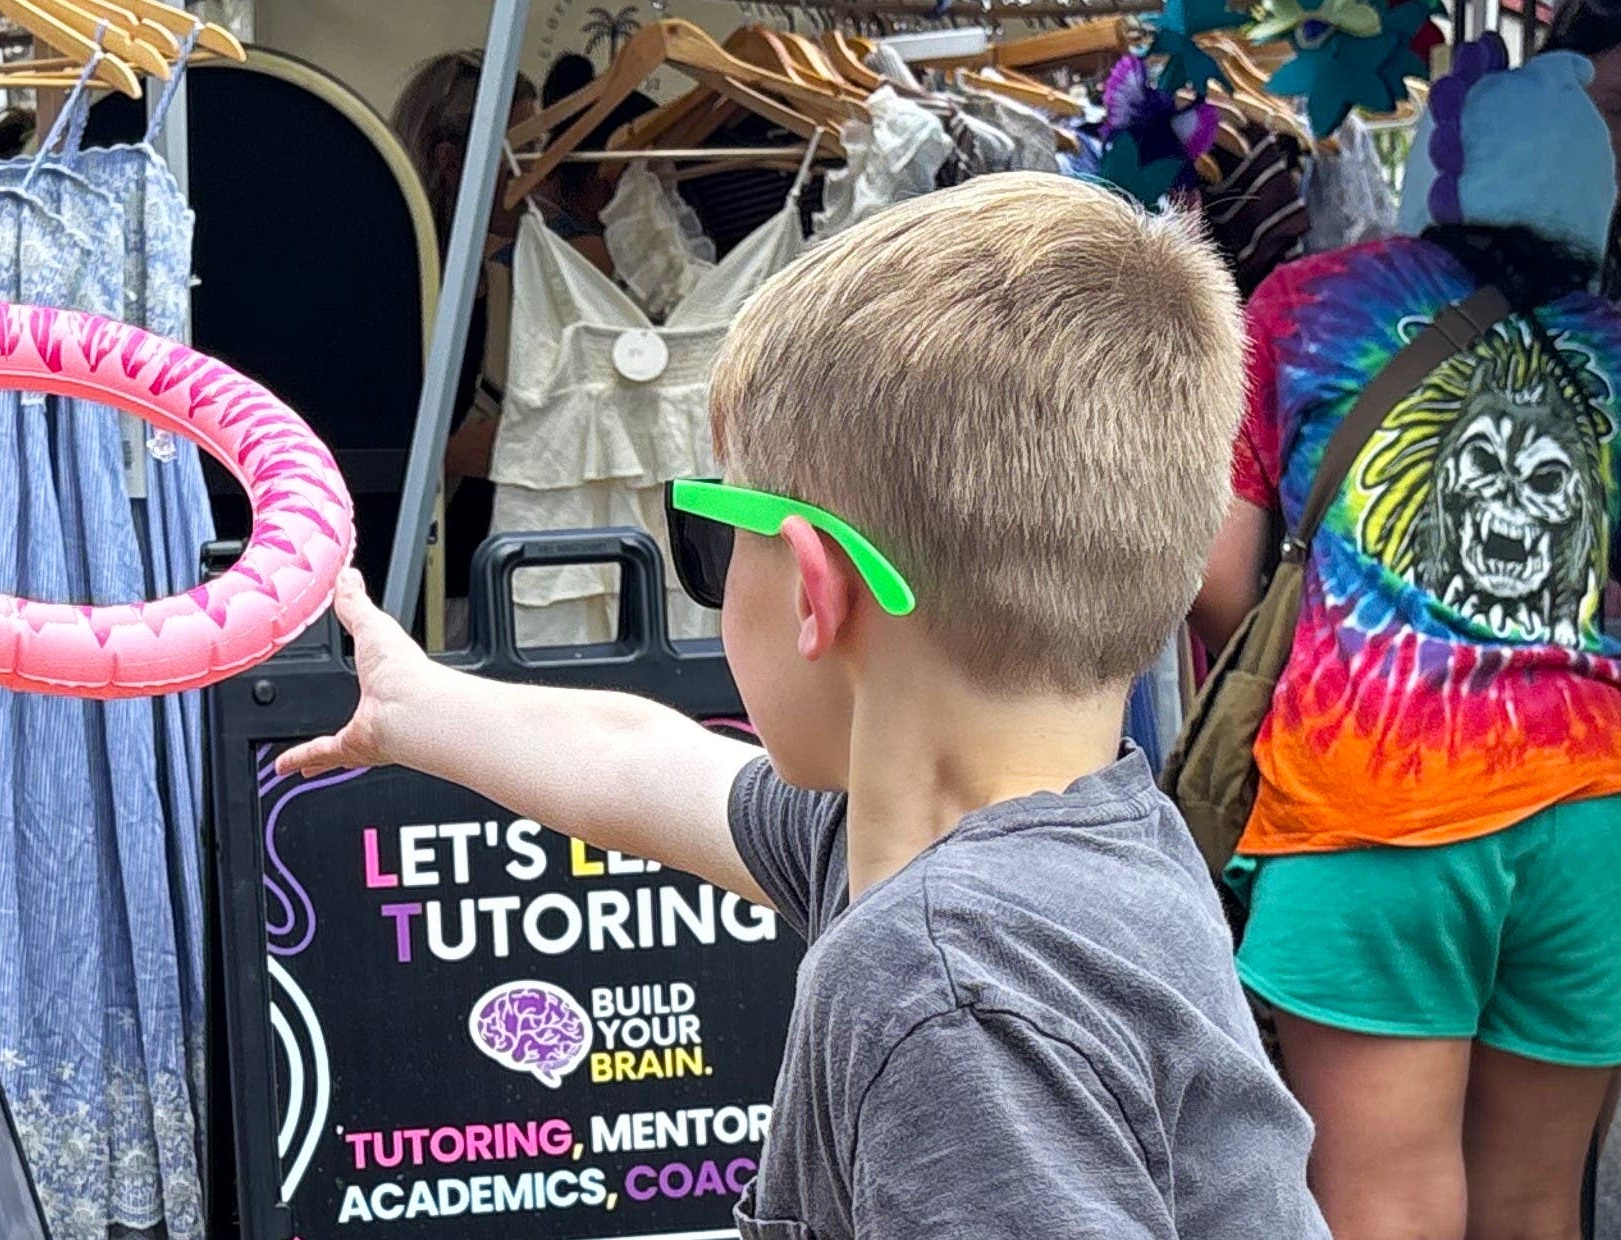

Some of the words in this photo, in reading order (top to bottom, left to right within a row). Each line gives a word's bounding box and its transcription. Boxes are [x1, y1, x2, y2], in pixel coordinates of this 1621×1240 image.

[364, 818, 548, 888] LET'S
[381, 883, 778, 962] TUTORING
[591, 982, 696, 1018] BUILD
[596, 1013, 702, 1050] YOUR
[590, 1046, 713, 1083] BRAIN.
[345, 1118, 584, 1169] TUTORING,
[338, 1167, 618, 1224] ACADEMICS,
